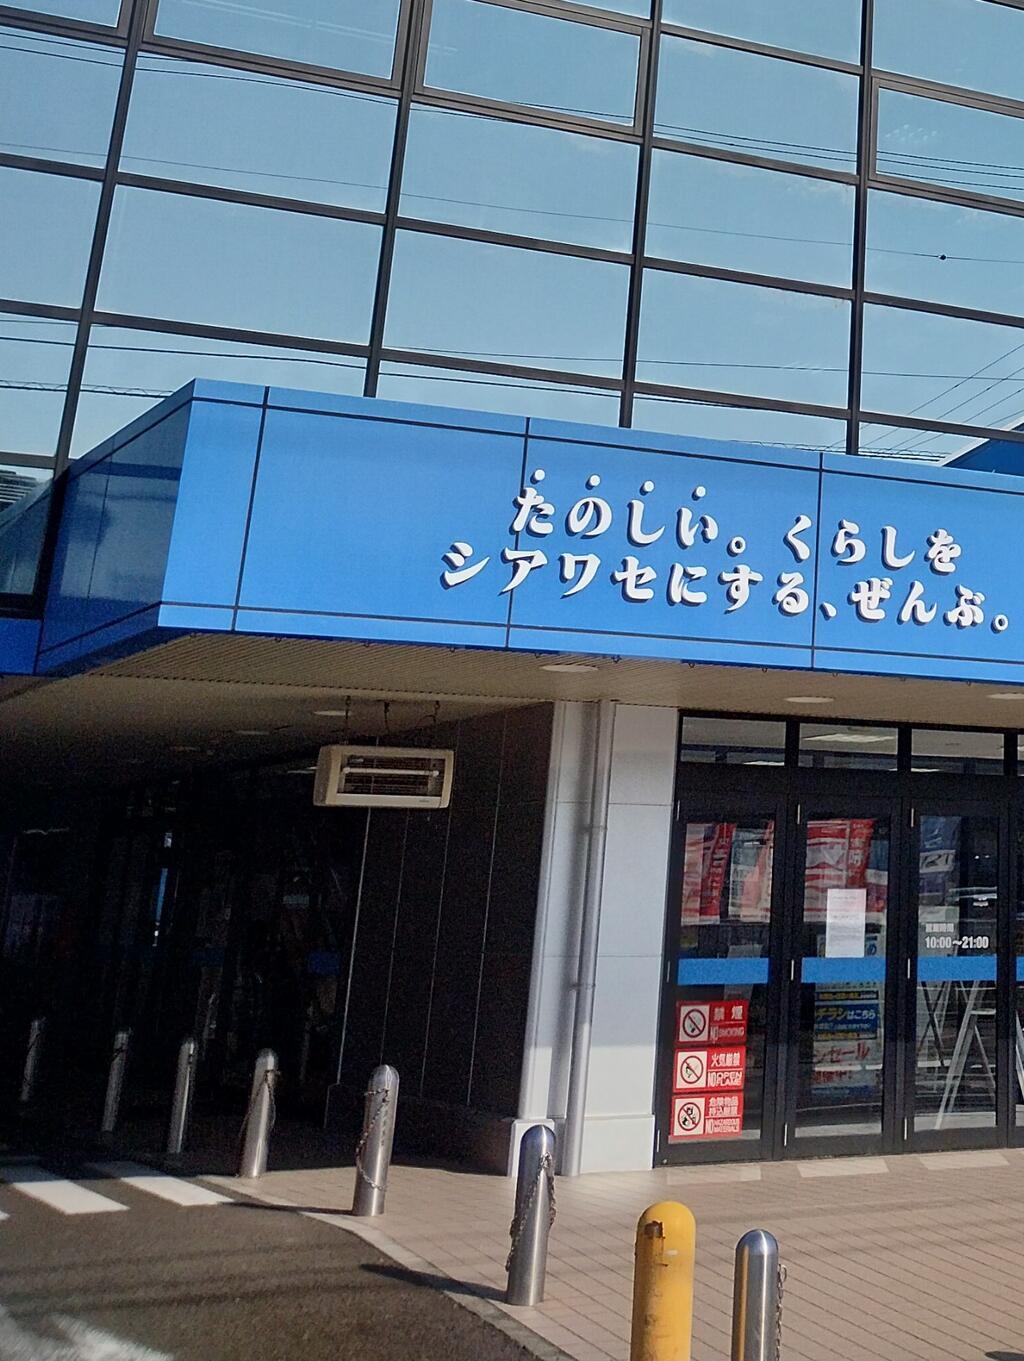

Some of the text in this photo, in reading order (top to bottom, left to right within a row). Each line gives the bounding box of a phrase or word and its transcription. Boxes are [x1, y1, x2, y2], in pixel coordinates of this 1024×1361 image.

[440, 541, 1009, 632] シアワセにする、ぜんぶ。
[718, 1071, 742, 1080] OPEN
